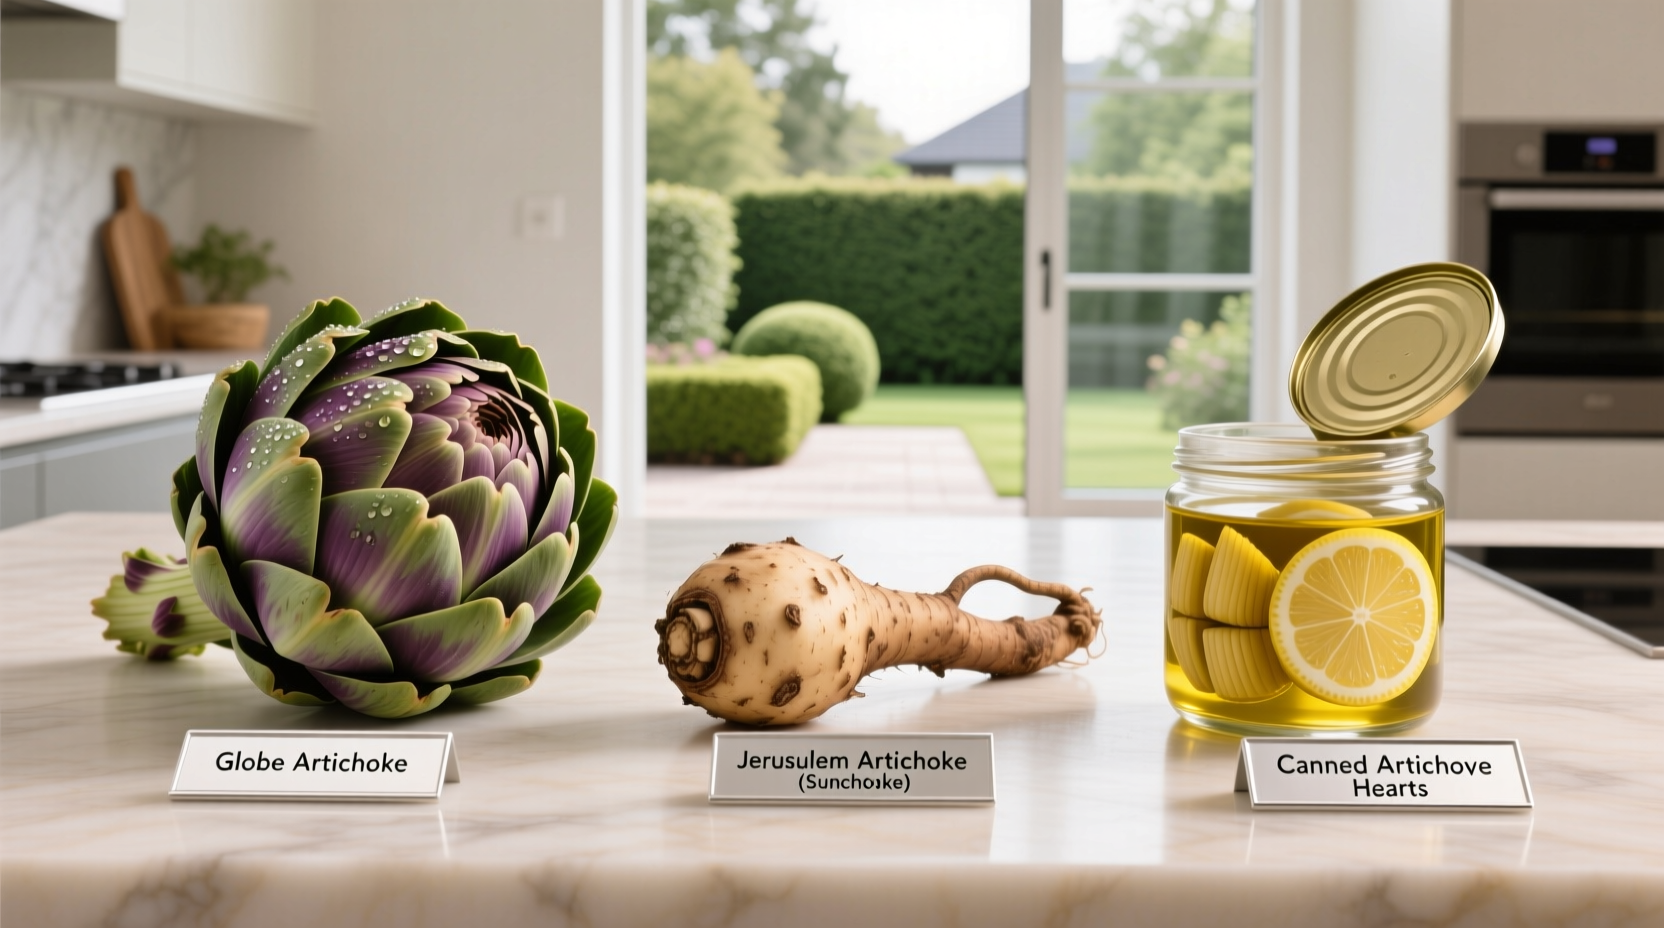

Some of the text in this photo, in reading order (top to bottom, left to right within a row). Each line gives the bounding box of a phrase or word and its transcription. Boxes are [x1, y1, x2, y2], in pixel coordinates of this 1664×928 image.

[215, 750, 408, 773] Globe Artichoke
[736, 749, 968, 771] Jerusulem Artichoke
[1277, 753, 1492, 776] Canned Artichove
[1352, 778, 1429, 798] Hearts
